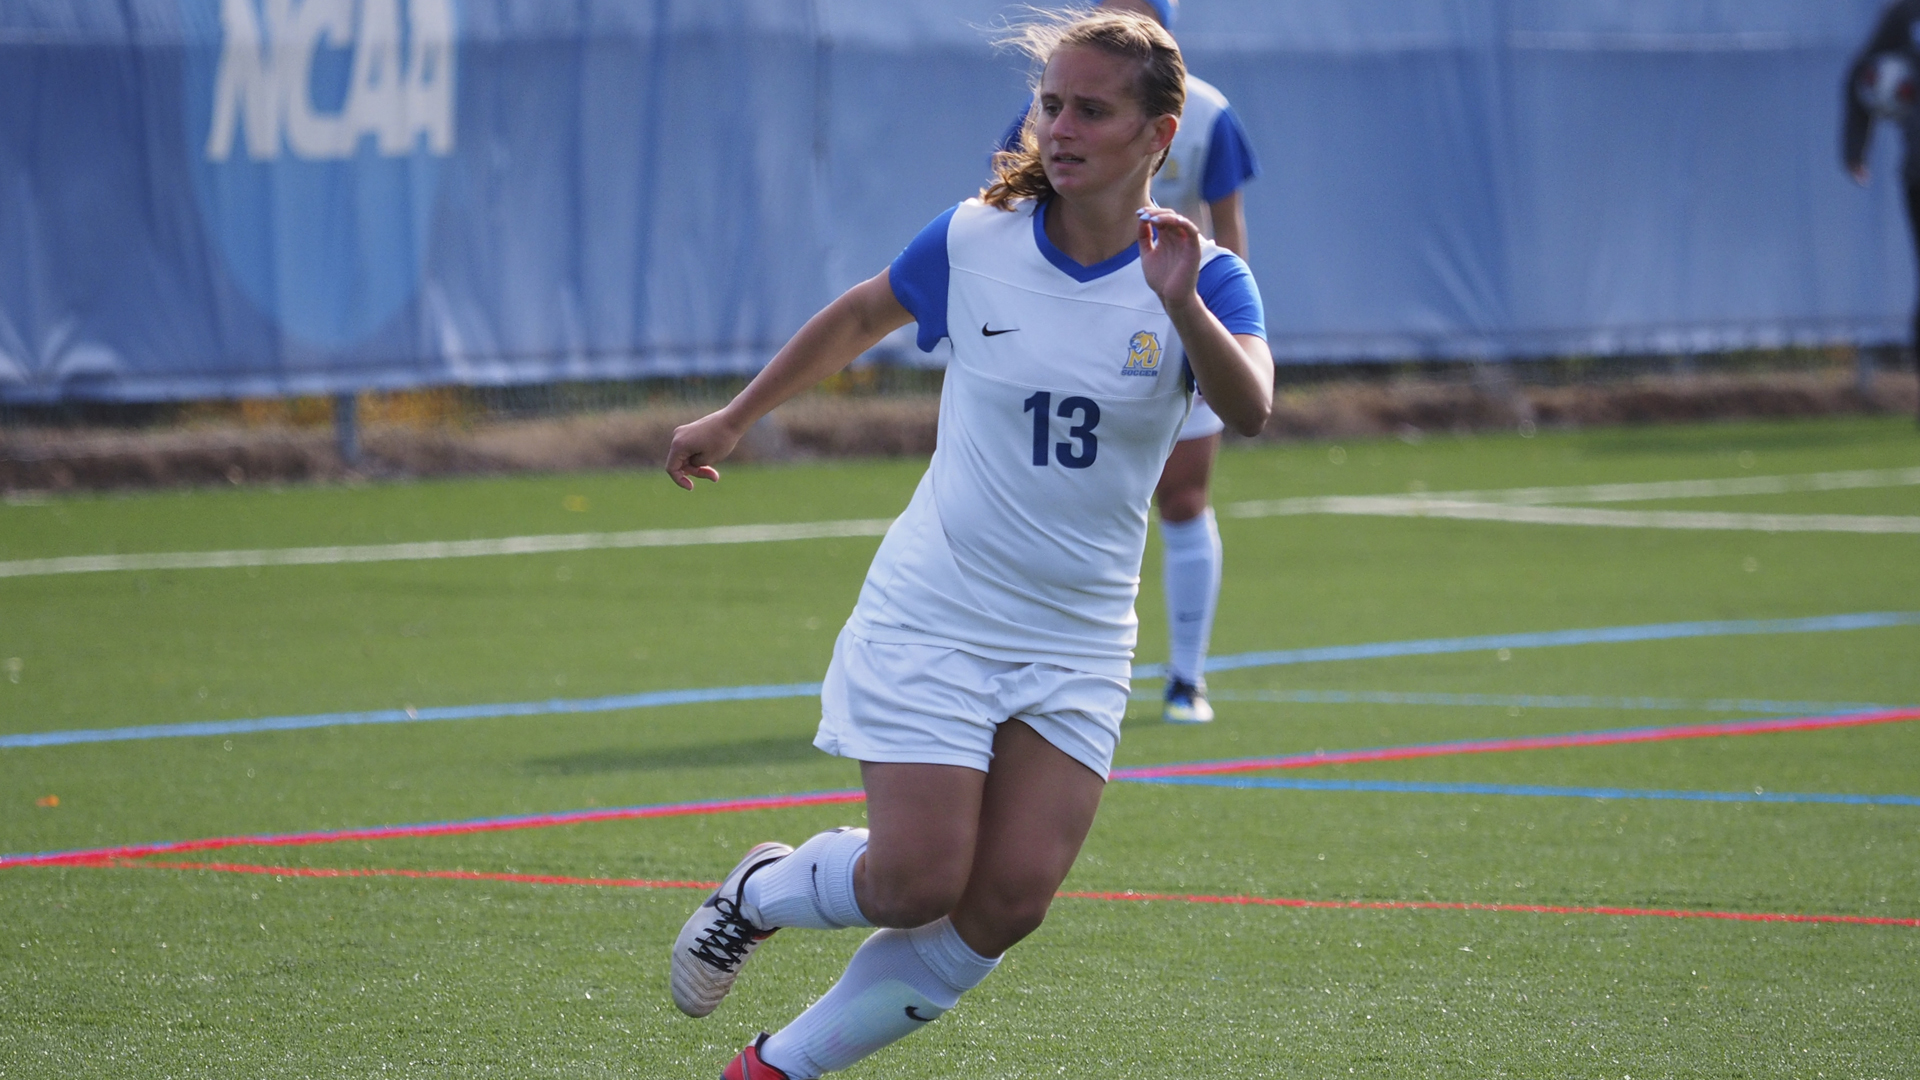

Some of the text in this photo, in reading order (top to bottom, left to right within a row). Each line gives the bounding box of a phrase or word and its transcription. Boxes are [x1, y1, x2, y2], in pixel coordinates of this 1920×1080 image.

[208, 0, 457, 161] NCAA
[1121, 369, 1158, 377] SOCCER
[1123, 348, 1162, 369] MU
[1024, 391, 1100, 469] 13
